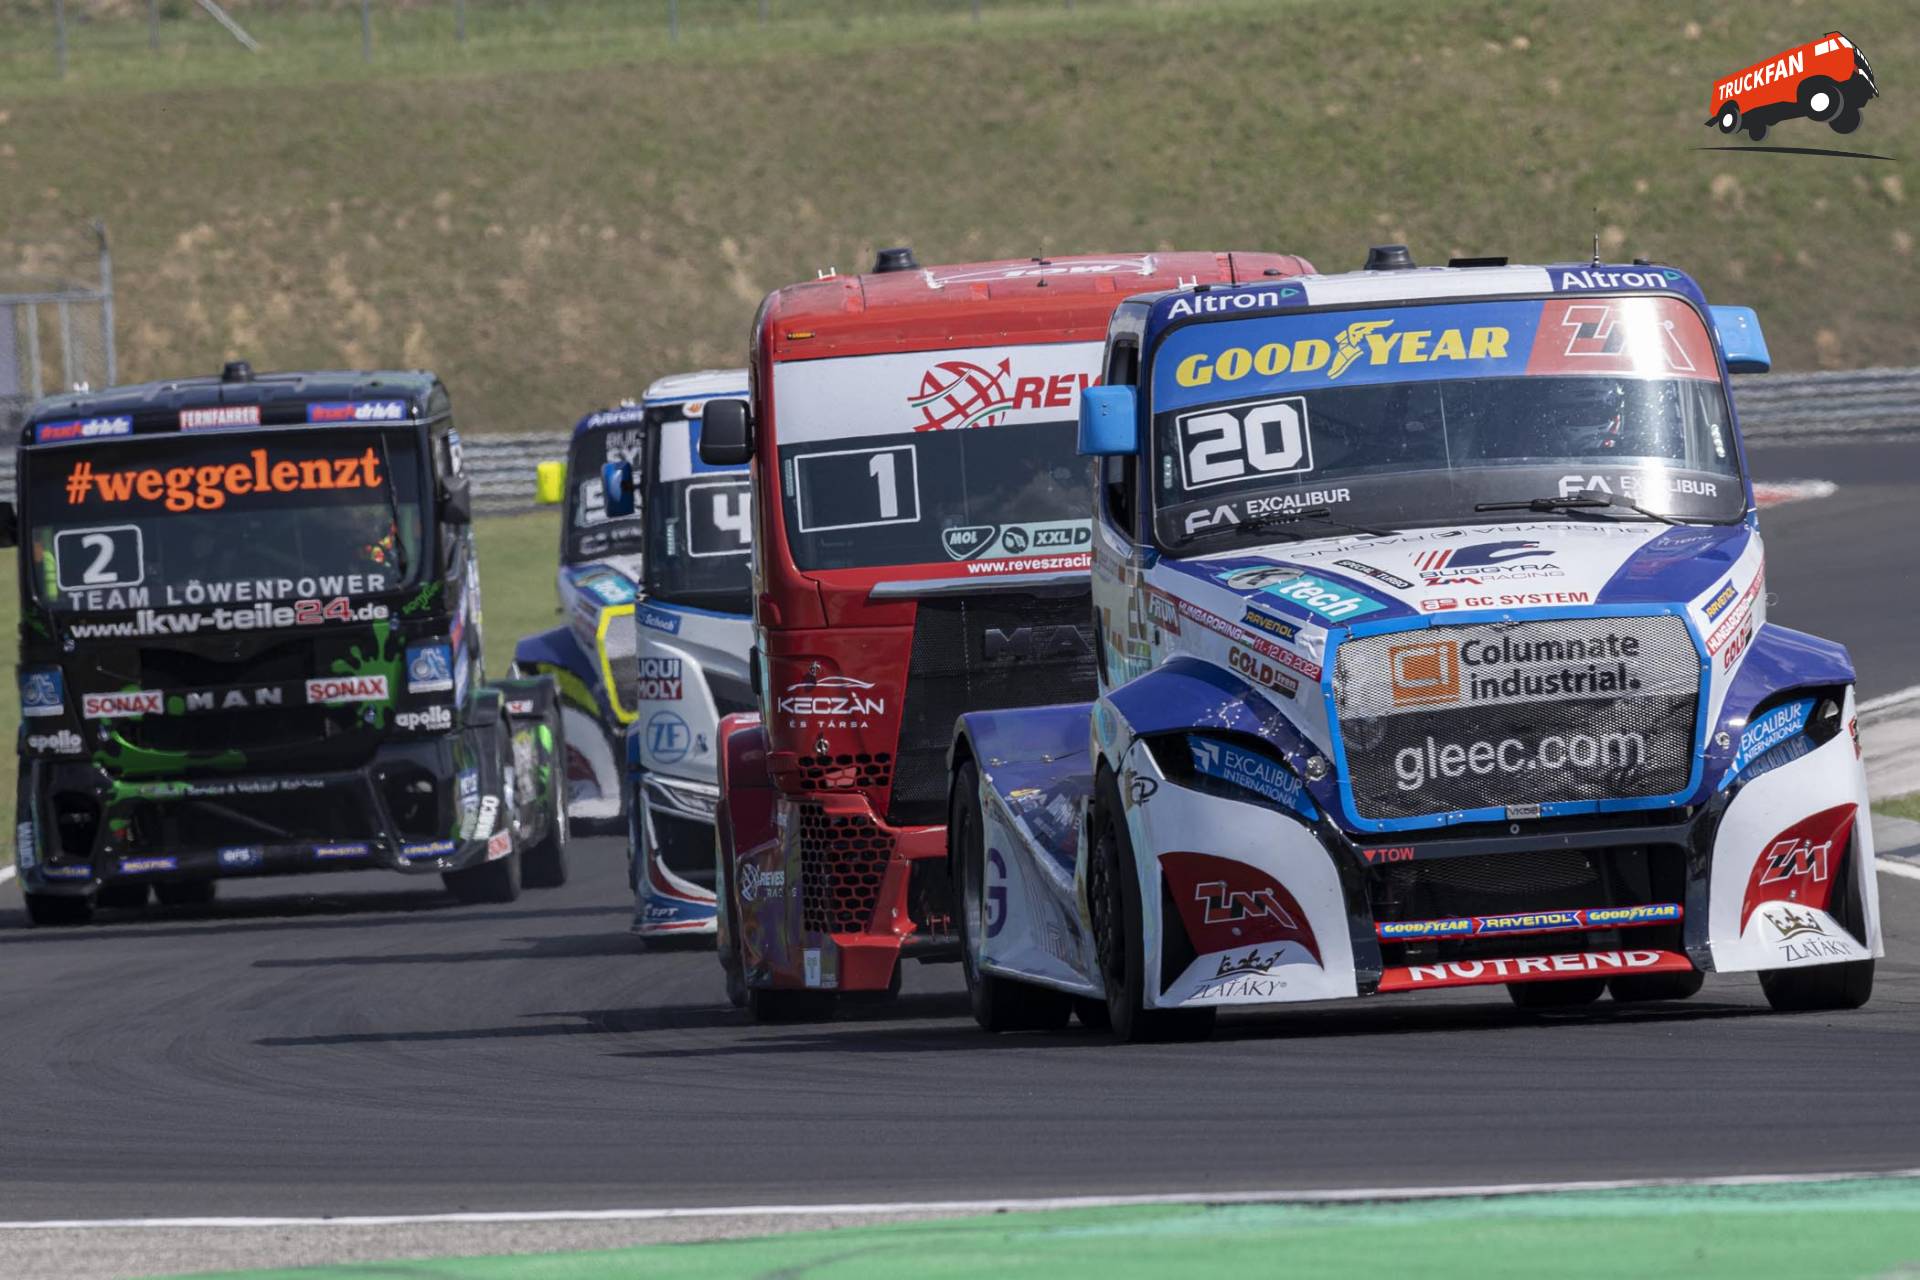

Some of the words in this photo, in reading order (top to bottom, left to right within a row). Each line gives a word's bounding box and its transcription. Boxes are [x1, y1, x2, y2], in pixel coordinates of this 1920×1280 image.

[1562, 270, 1667, 290] Altron
[1167, 291, 1279, 319] Altron
[1186, 404, 1303, 483] 20
[66, 447, 383, 512] #weggelenzt
[869, 453, 898, 518] 1
[1246, 488, 1351, 514] EXCALIBUR
[949, 531, 978, 545] MOL
[1035, 531, 1071, 546] XXL
[81, 534, 118, 584] 2
[1419, 563, 1560, 579] BUGGYRA
[1480, 571, 1566, 582] RACING
[68, 587, 150, 611] TEAM
[166, 574, 385, 605] LÖWENPOWER
[1279, 580, 1362, 617] tech
[1465, 596, 1494, 607] GC
[1500, 591, 1589, 605] SYSTEM
[70, 598, 389, 639] www.lkw-teile24.de
[1246, 611, 1294, 638] RAVENOL
[1461, 632, 1640, 667] Columnate
[639, 660, 680, 678] IQUI
[1228, 646, 1274, 685] GOLD
[187, 685, 283, 711] MAN
[310, 678, 385, 699] SONAX
[86, 695, 160, 714] SONAX
[395, 705, 452, 730] apollo
[28, 730, 82, 753] apollo
[1741, 703, 1803, 751] EXCALIBUR
[1743, 719, 1803, 764] INTERNATIONAL
[1225, 750, 1302, 798] EXCALIBUR
[1395, 732, 1645, 791] gleec.com
[1223, 767, 1297, 810] INTERNATIONAL
[1379, 848, 1414, 862] TOW
[1758, 838, 1833, 886] ZM
[1384, 919, 1469, 935] GOODYEAR
[1486, 912, 1573, 929] RAVENOL
[1589, 905, 1676, 922] GOODYEAR
[1408, 950, 1664, 982] NUTREND
